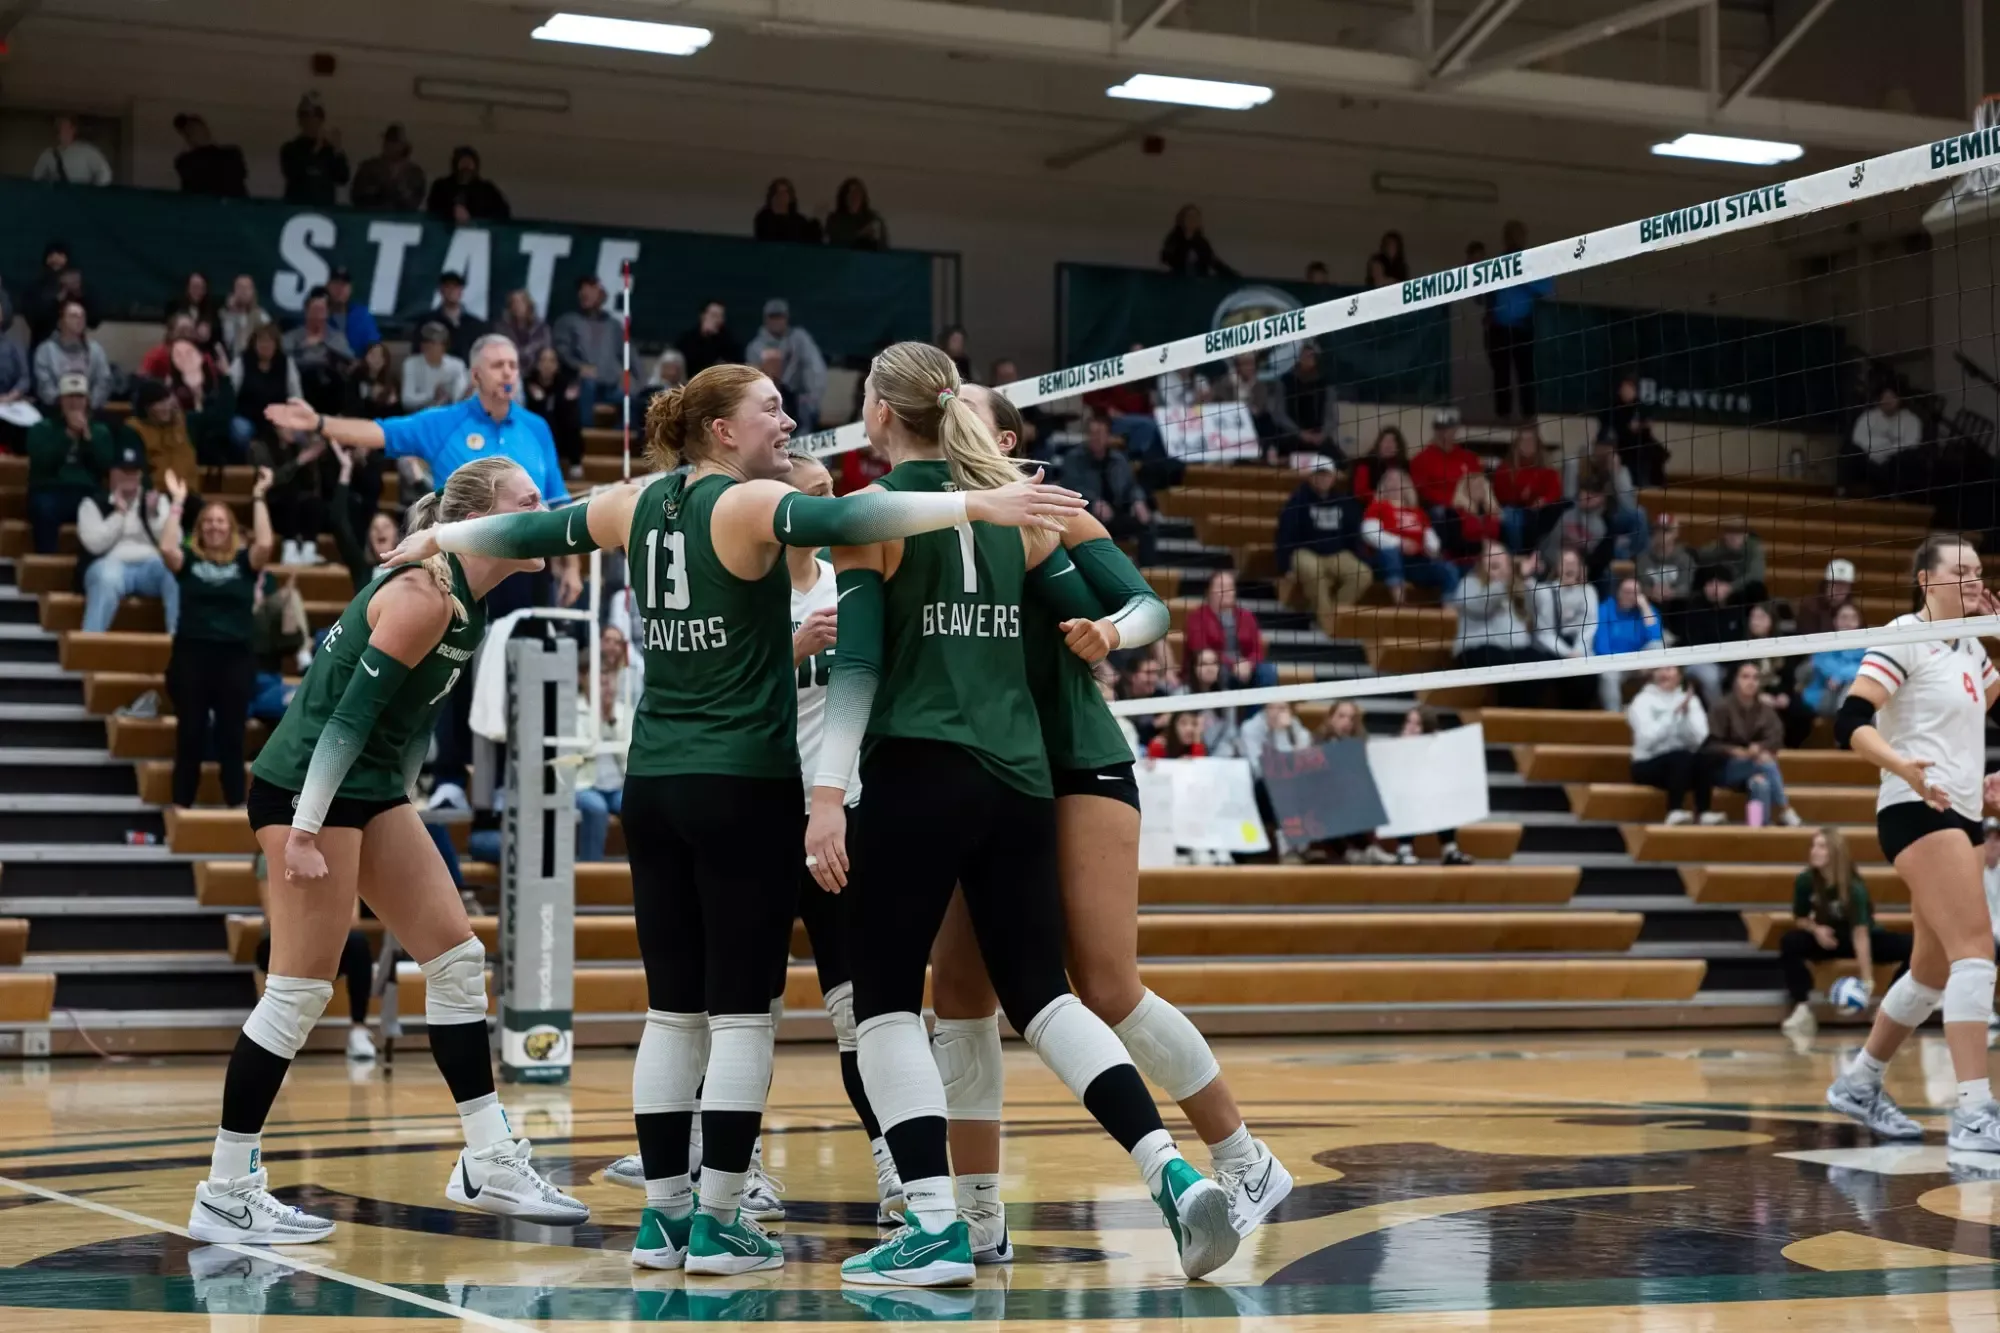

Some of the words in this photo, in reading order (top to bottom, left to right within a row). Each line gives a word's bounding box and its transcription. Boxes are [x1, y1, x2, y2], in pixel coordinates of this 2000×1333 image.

[1640, 201, 1720, 244] BEMIDJI
[1725, 184, 1787, 222] STATE
[272, 213, 640, 326] STATE
[1402, 267, 1468, 305] BEMIDJI
[1473, 253, 1523, 287] STATE
[1205, 321, 1261, 354] BEMIDJI
[1264, 310, 1306, 340] STATE
[1039, 366, 1086, 396] BEMIDJI
[1089, 356, 1125, 383] STATE
[646, 529, 691, 610] 13
[954, 522, 978, 593] 1
[922, 602, 1020, 638] BEAVERS
